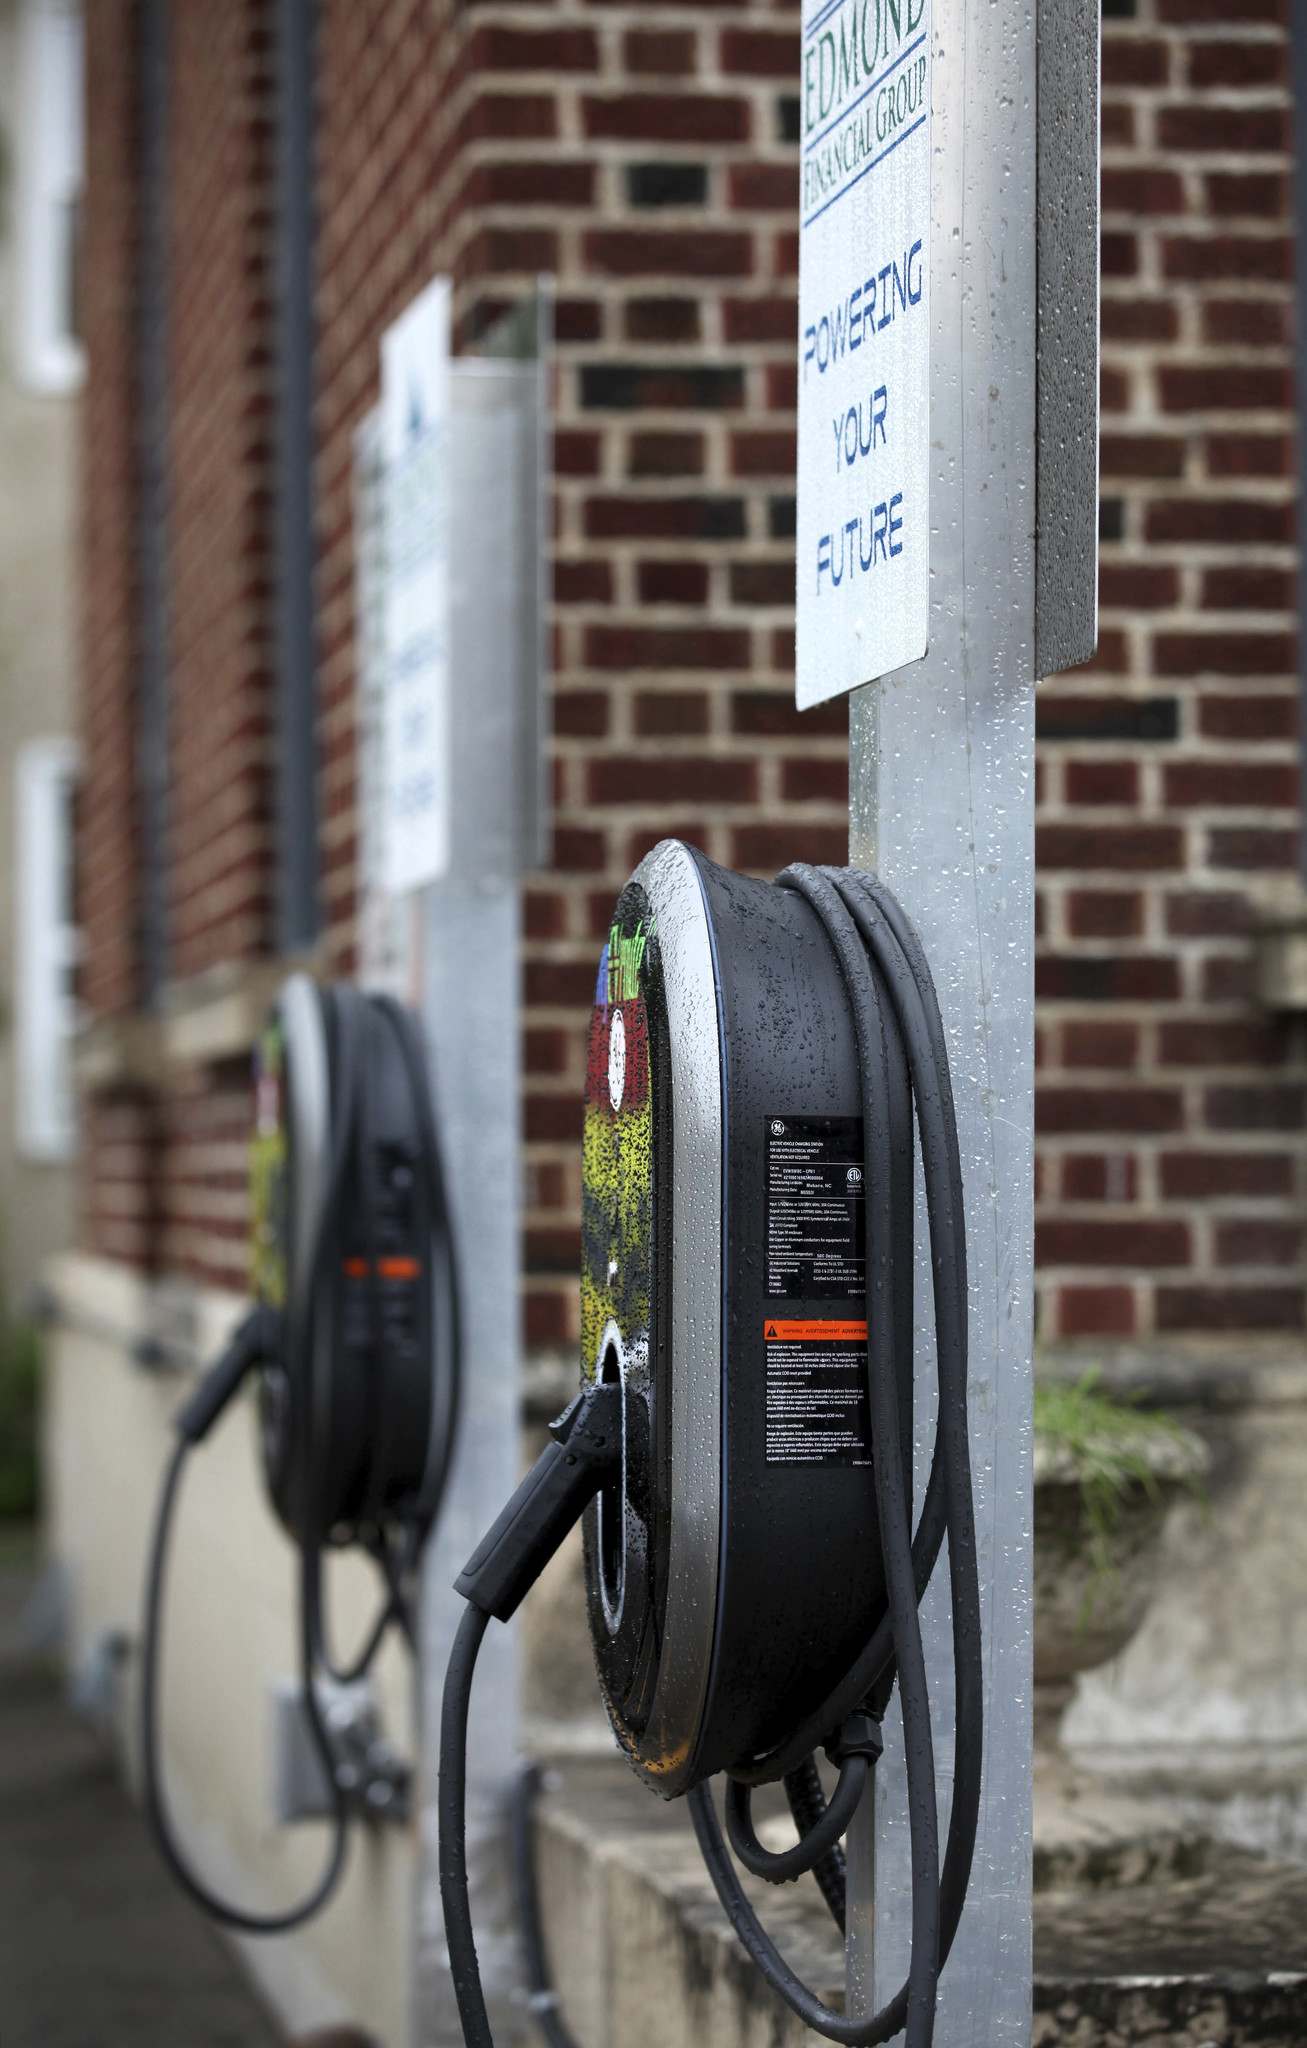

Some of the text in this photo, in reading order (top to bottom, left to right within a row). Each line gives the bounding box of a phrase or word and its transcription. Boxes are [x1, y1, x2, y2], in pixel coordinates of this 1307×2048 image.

[803, 55, 926, 211] FINANCIAL GROUP
[803, 238, 922, 384] POWERING
[833, 385, 887, 473] YOUR
[817, 491, 903, 596] FUTURE
